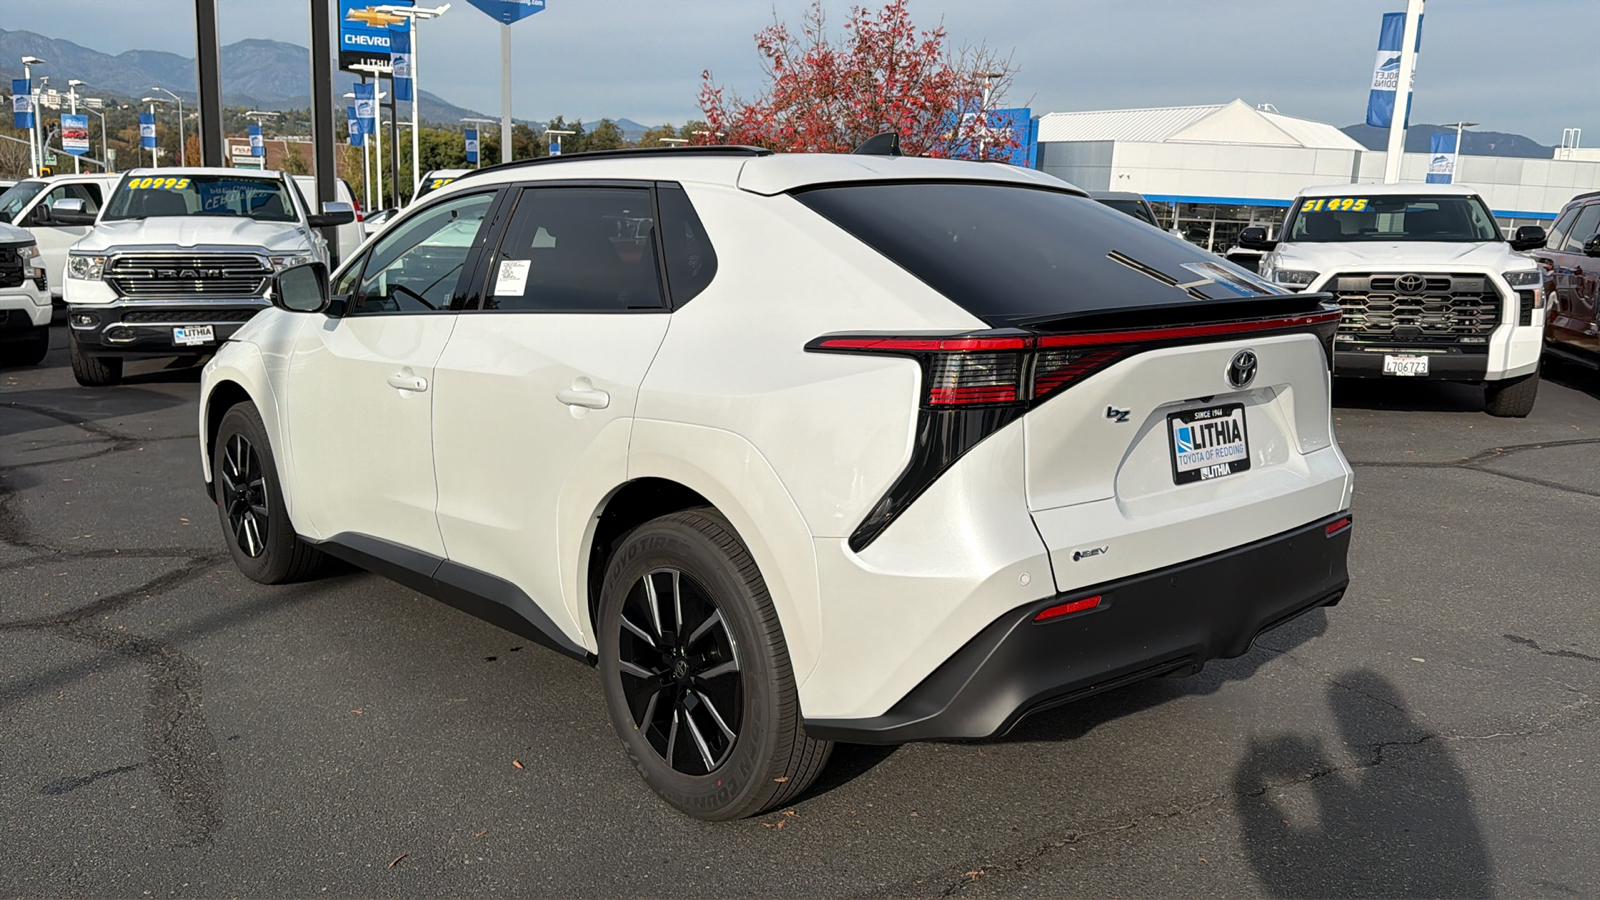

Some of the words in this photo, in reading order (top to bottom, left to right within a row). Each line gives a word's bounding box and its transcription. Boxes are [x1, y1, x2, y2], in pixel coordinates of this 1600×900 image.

[128, 177, 190, 189] 40995
[157, 268, 220, 278] RAM
[184, 328, 212, 337] LITHIA
[1194, 410, 1211, 420] SINCE
[1190, 419, 1242, 451] LITHIA
[1178, 452, 1205, 466] TOYOTA
[1205, 449, 1215, 461] OF
[1215, 443, 1244, 458] REDDING
[1207, 462, 1231, 478] LITHIA
